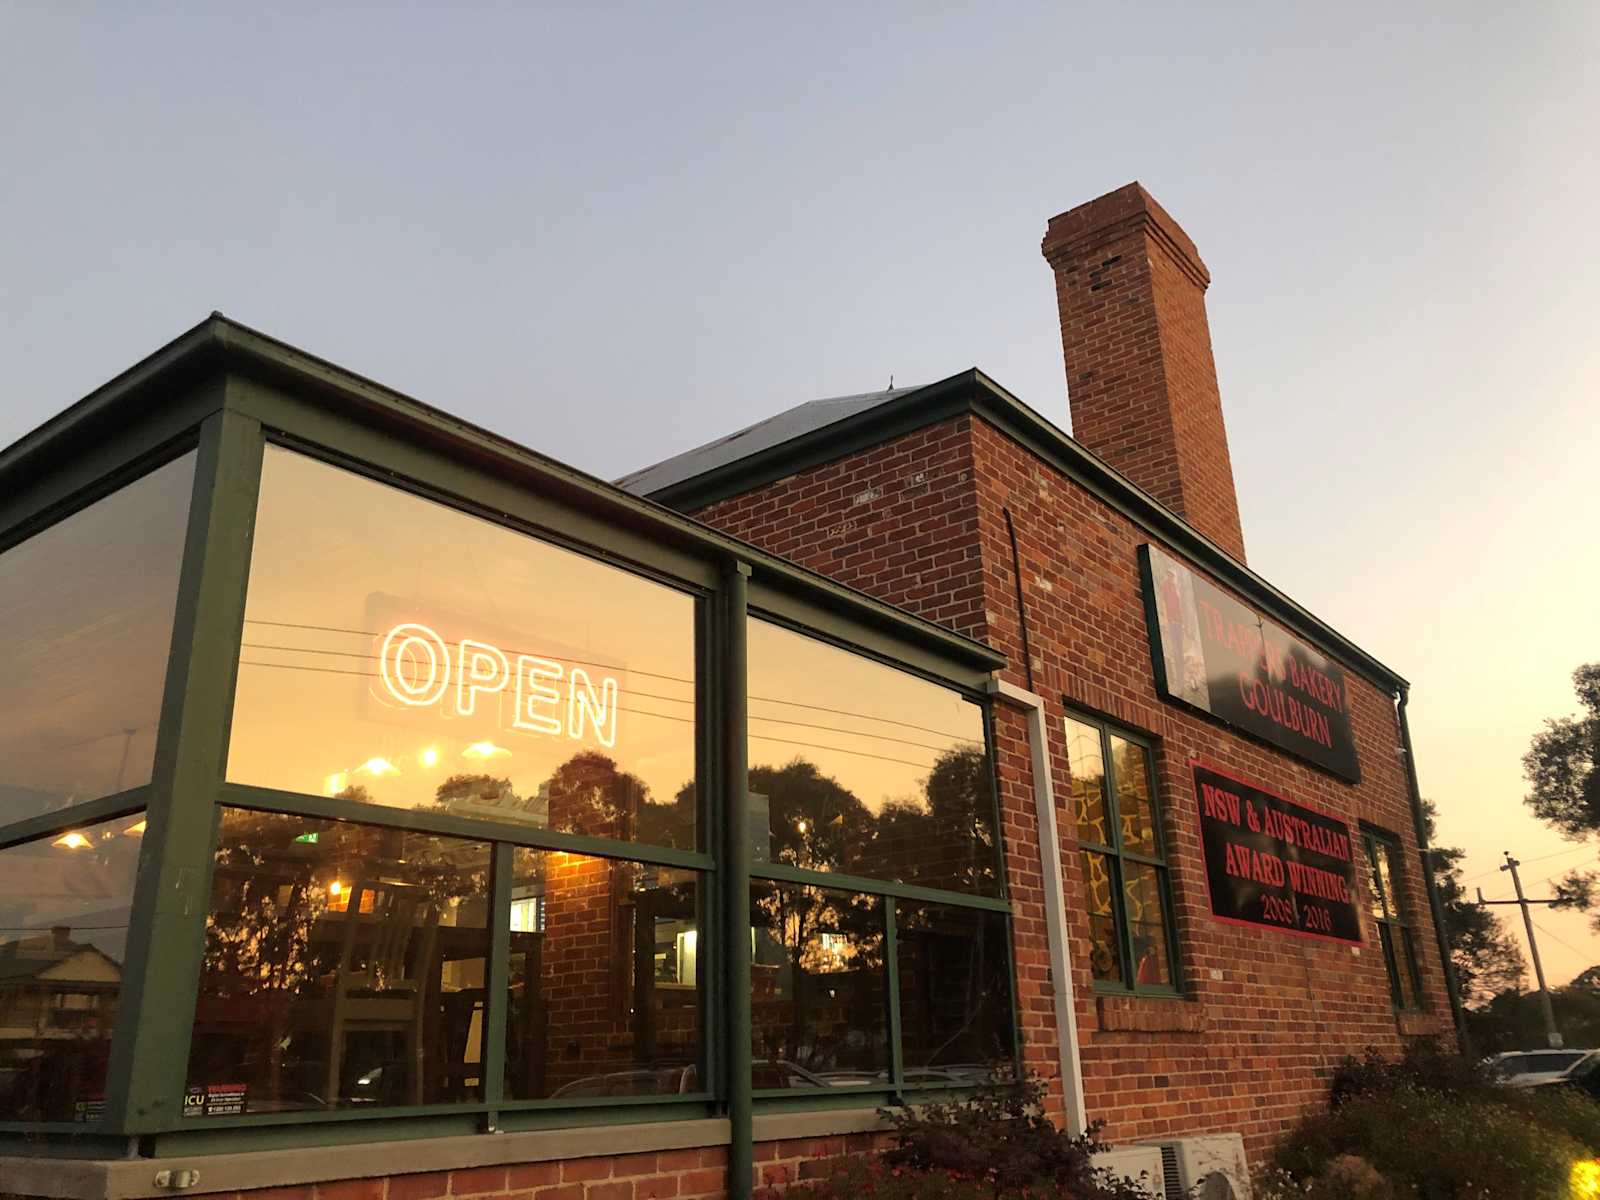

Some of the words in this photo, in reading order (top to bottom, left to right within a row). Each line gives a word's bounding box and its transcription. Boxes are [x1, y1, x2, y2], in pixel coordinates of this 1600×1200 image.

[381, 623, 617, 747] OPEN
[1238, 672, 1332, 748] GOULBURN
[1287, 655, 1343, 713] BAKERY
[1201, 784, 1241, 826] NSW
[1247, 800, 1261, 832] &
[1264, 806, 1349, 861] AUSTRALIAN
[1226, 842, 1285, 887] AWARD
[1286, 860, 1349, 904] WINNING
[184, 1095, 205, 1105] ICU
